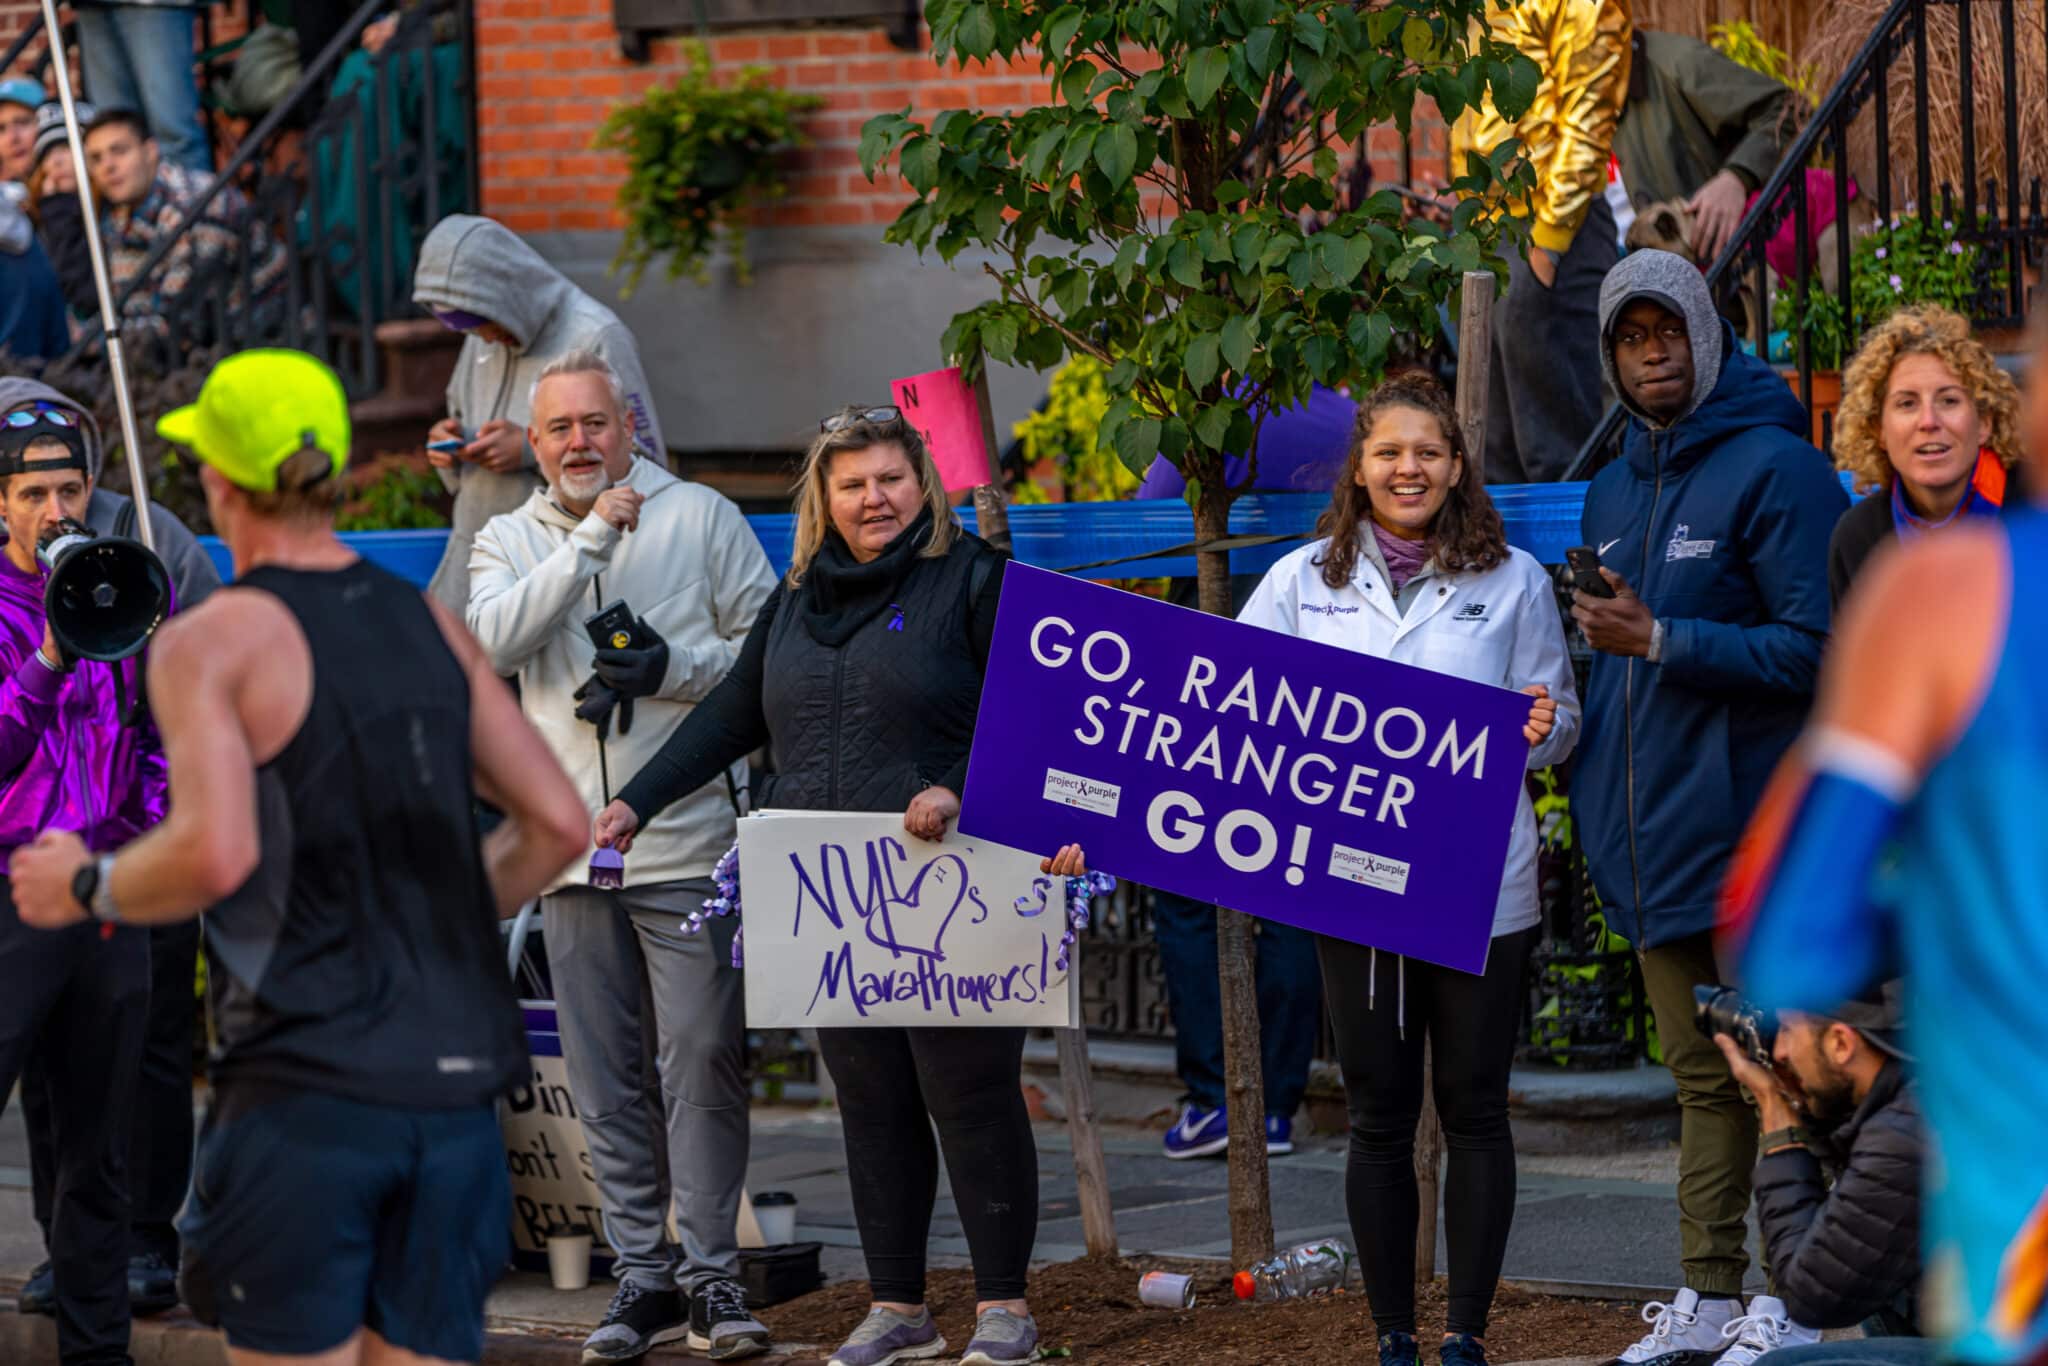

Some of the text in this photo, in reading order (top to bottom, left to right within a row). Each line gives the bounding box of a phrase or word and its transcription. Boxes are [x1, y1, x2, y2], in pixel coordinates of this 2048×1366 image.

[902, 383, 919, 409] N
[1030, 616, 1489, 780] GO, RANDOM
[1047, 775, 1079, 789] project
[1088, 785, 1118, 800] purple
[1074, 695, 1415, 828] STRANGER
[1146, 790, 1313, 888] GO!
[1333, 851, 1366, 865] project
[1375, 862, 1407, 877] purple
[789, 836, 908, 959] NYC
[806, 932, 1047, 1016] Marathoners!
